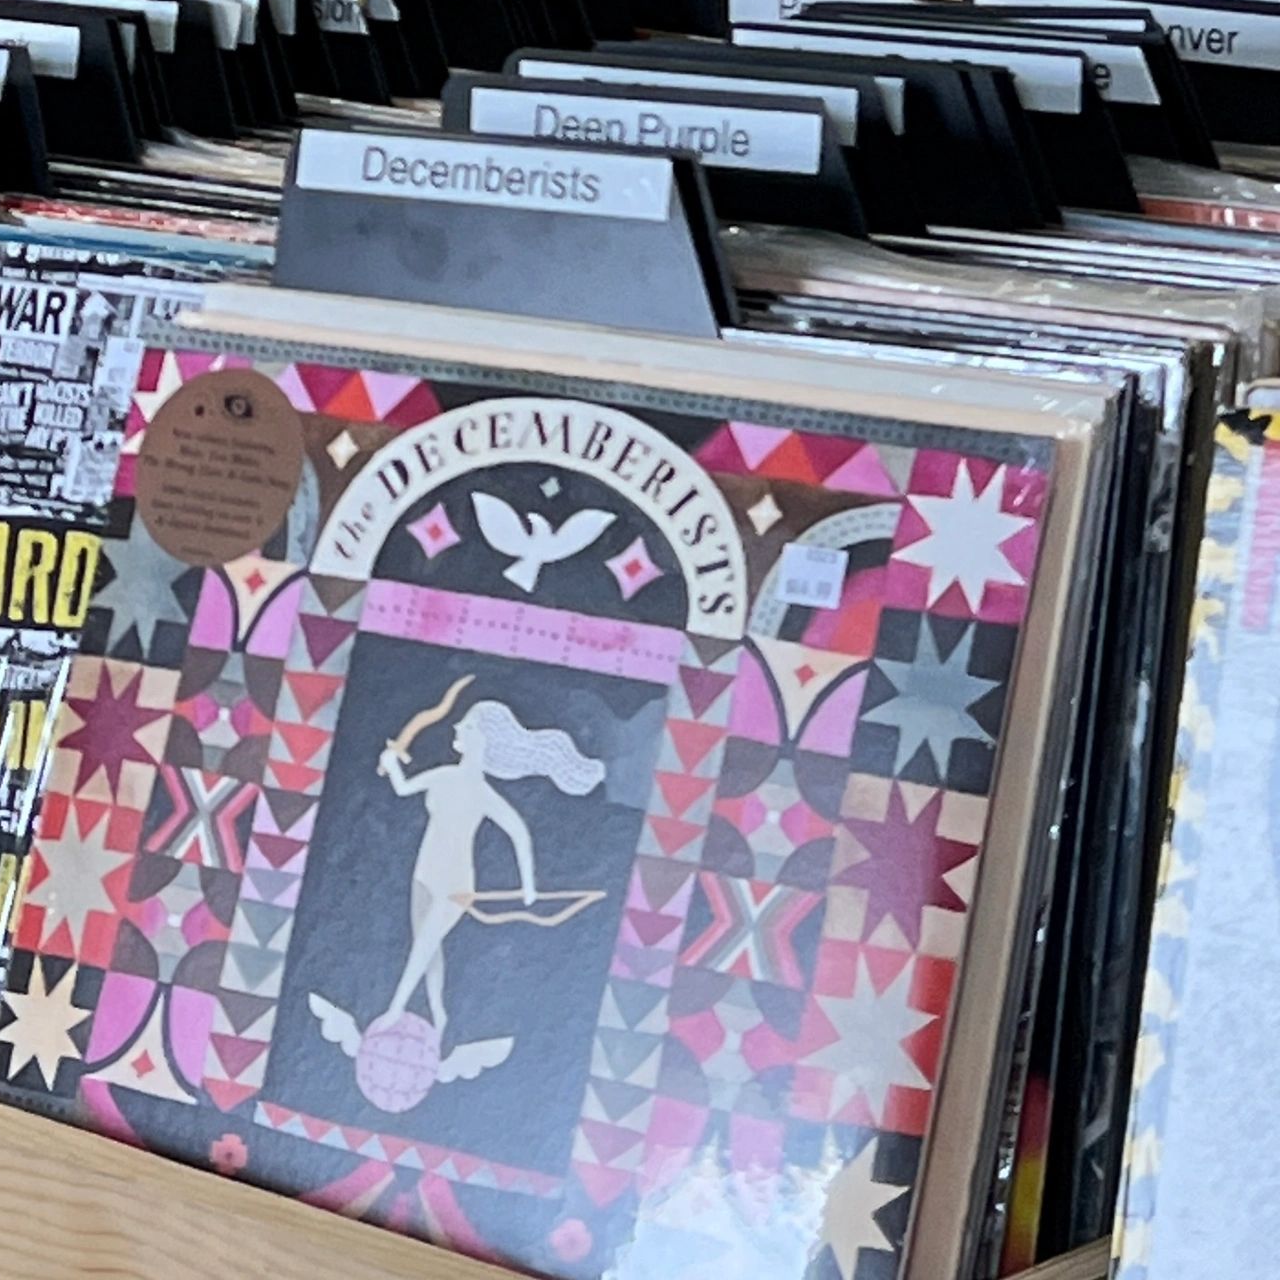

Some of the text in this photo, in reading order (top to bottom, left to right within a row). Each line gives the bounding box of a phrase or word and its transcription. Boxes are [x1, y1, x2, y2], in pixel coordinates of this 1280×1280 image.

[637, 113, 751, 158] Purple
[361, 145, 602, 204] Decemberists
[334, 501, 377, 560] the
[376, 411, 738, 616] DECEMBERISTS
